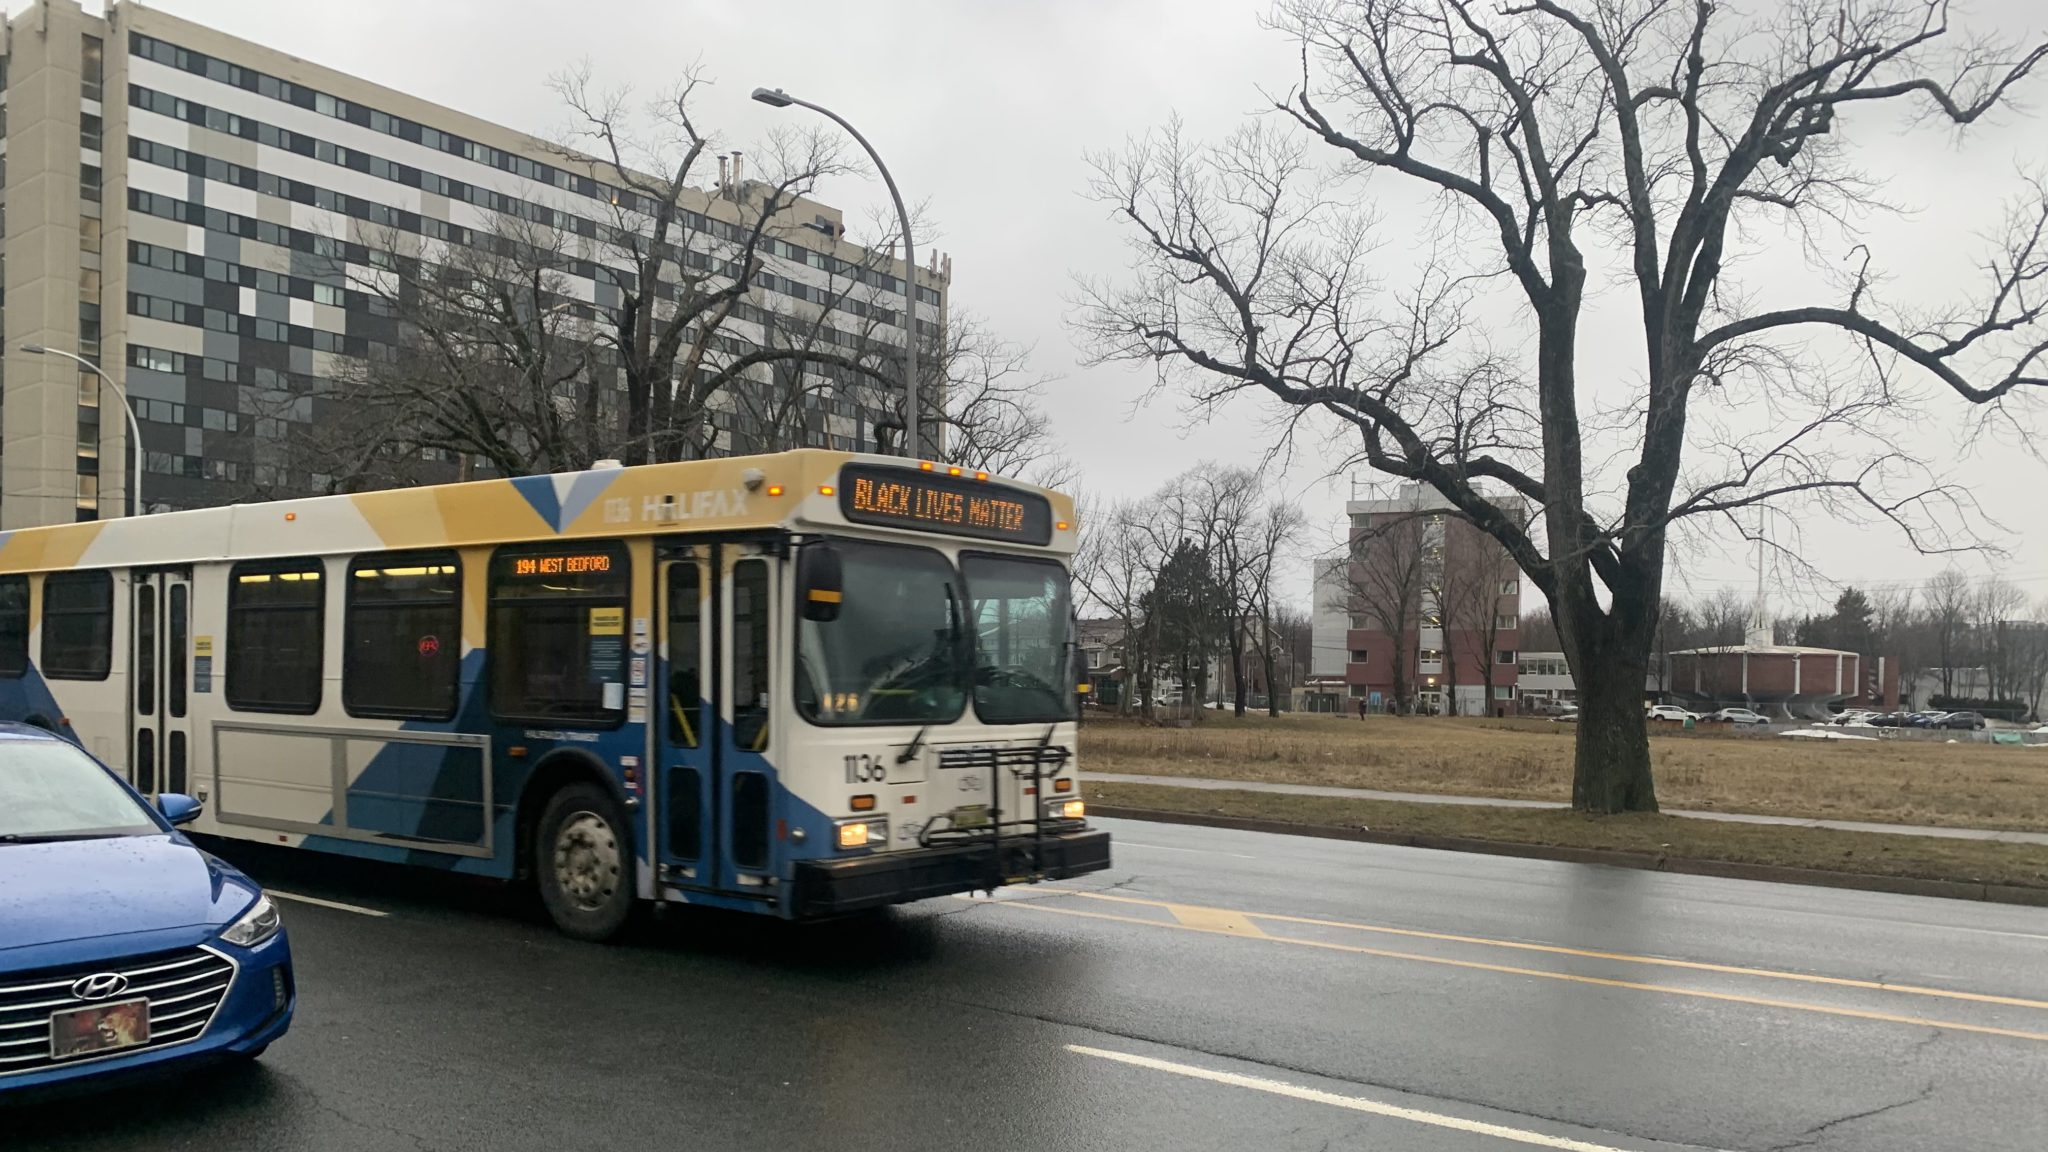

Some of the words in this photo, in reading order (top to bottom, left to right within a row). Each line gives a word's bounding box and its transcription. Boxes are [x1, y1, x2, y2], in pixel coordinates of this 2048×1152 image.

[854, 478, 911, 517] BLACK
[915, 488, 963, 524] LIVES
[968, 496, 1024, 532] MATTER
[516, 559, 537, 574] 194
[540, 557, 564, 573] WEST
[566, 556, 610, 572] BEDFORD
[843, 753, 886, 784] 1136
